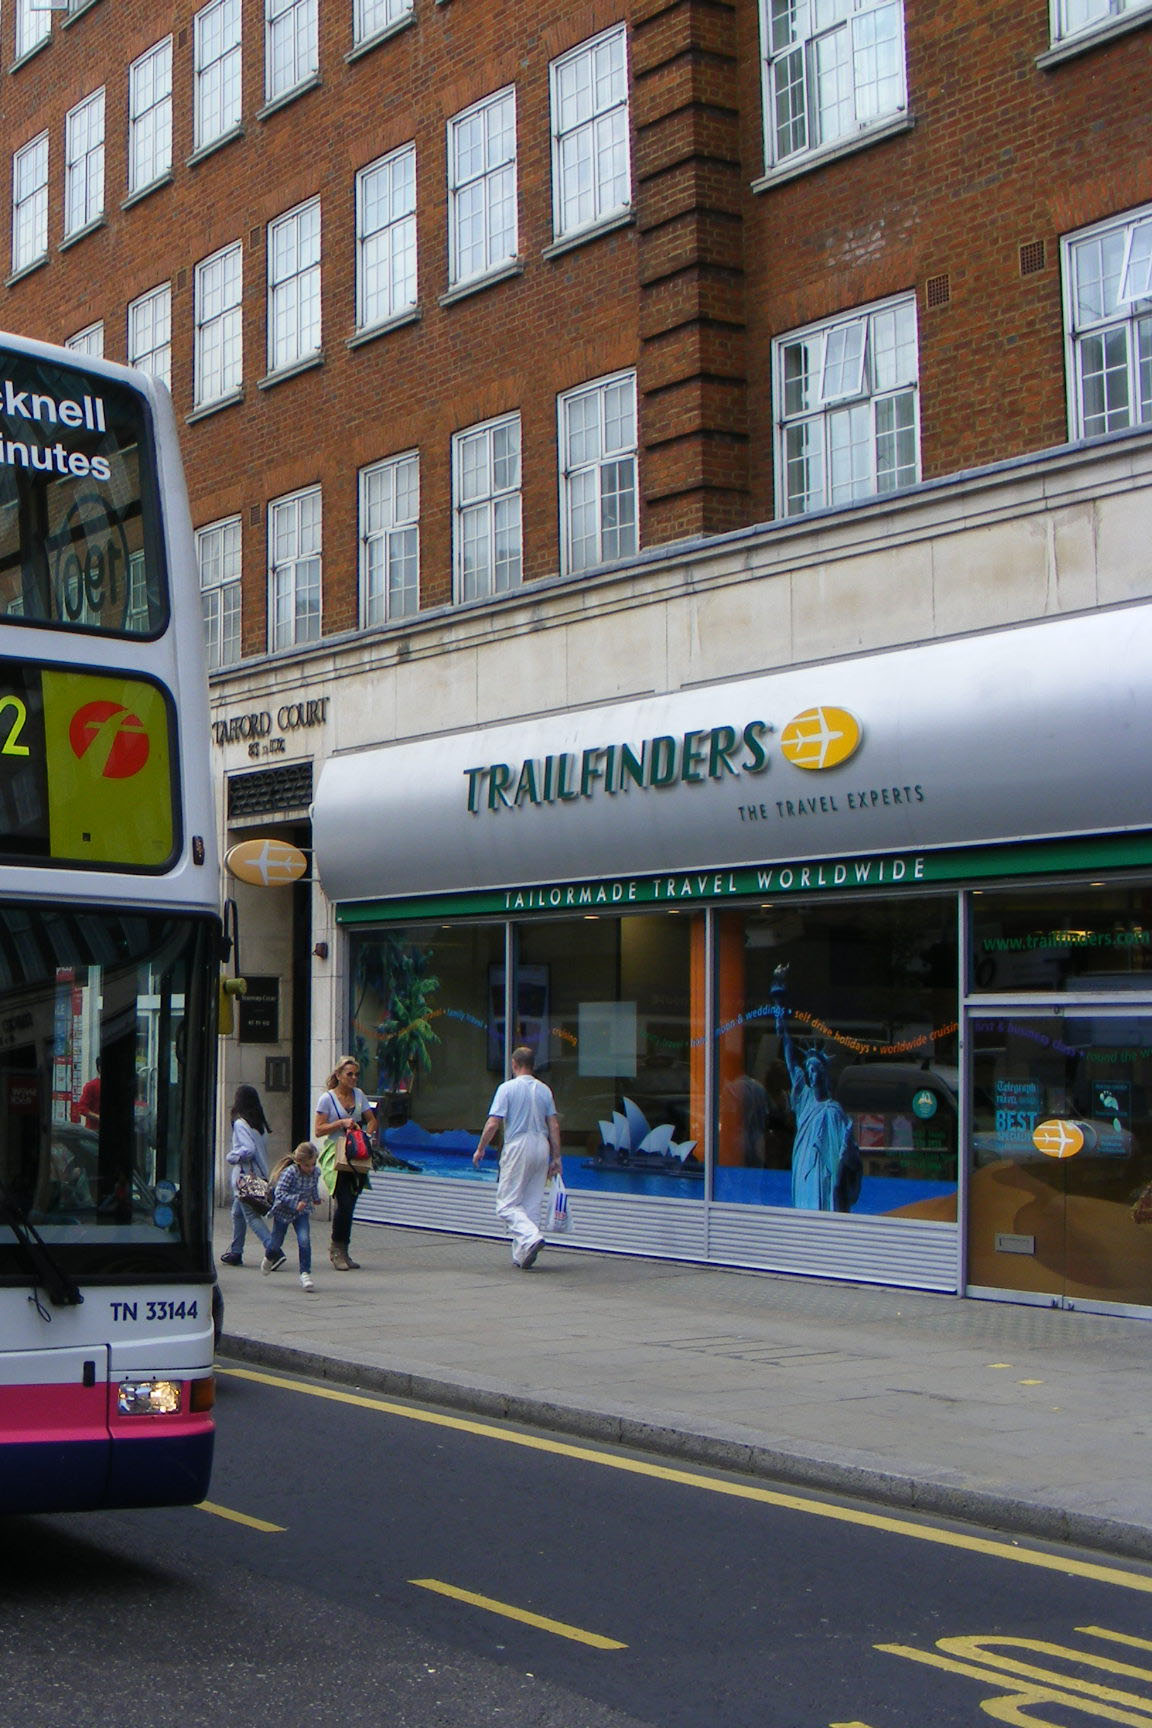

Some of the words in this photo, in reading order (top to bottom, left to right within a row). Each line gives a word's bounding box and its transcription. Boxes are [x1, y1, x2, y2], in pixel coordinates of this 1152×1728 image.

[212, 711, 272, 746] TAFFORD
[277, 697, 330, 732] COURT
[463, 720, 773, 813] TRAILFINDERS
[738, 804, 768, 822] THE
[776, 796, 838, 817] TRAVEL
[848, 784, 925, 809] EXPERTS
[505, 882, 637, 908] TAILORMADE
[653, 874, 736, 898] TRAVEL
[757, 858, 924, 889] WORLDWIDE
[984, 931, 1149, 950] www.trailfinders.com
[745, 1004, 784, 1020] weddings
[794, 1009, 812, 1023] self
[811, 1018, 833, 1037] drive
[833, 1031, 870, 1054] holidays
[880, 1034, 927, 1055] worldwide
[929, 1020, 959, 1041] cruisin
[995, 1110, 1038, 1133] BEST
[110, 1302, 138, 1321] TN
[145, 1301, 198, 1321] 33144
